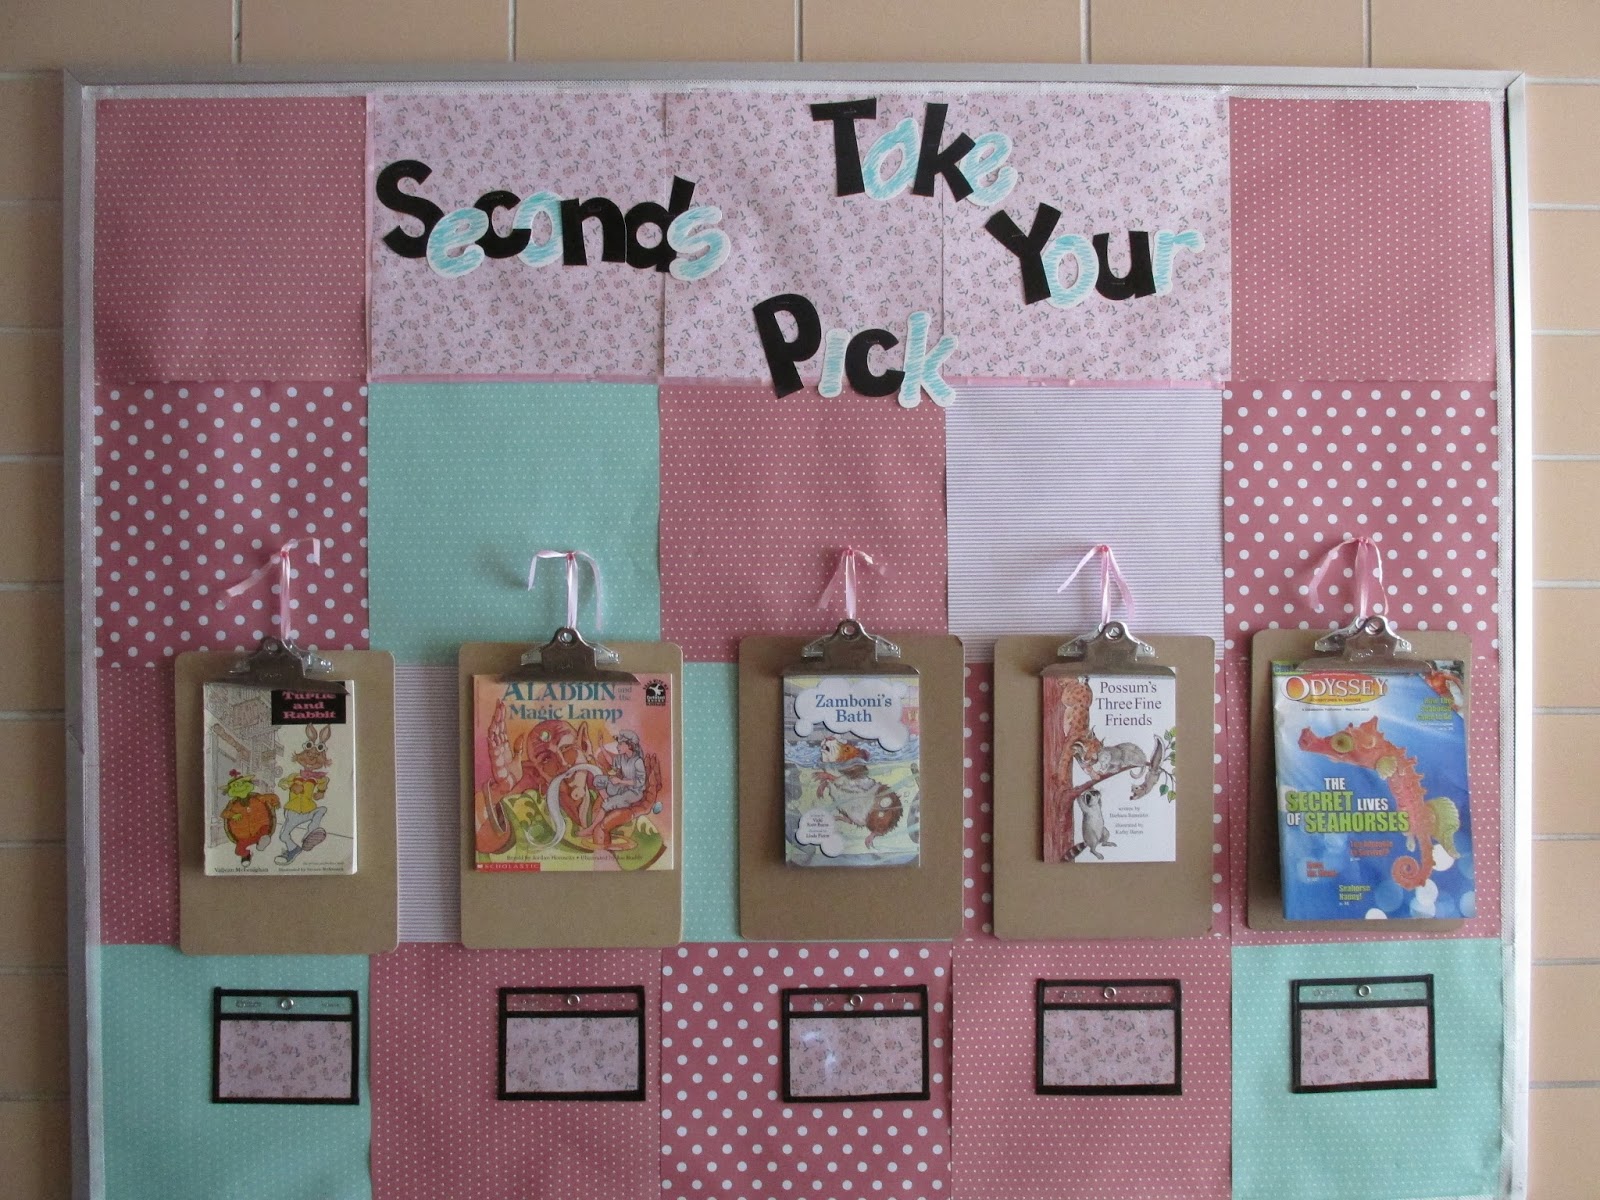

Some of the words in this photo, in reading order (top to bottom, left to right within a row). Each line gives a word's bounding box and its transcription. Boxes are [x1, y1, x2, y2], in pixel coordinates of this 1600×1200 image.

[811, 98, 1018, 206] Take
[376, 160, 730, 280] Seconds
[985, 203, 1205, 309] Your
[754, 293, 958, 407] Pick
[503, 682, 616, 701] ALADDIN
[1100, 681, 1157, 693] Possum's
[1281, 676, 1388, 700] ODYSSEY
[293, 701, 325, 709] and
[816, 694, 892, 707] Zamboni's
[1095, 697, 1133, 710] Three
[1134, 697, 1162, 710] Fine
[282, 711, 336, 719] Rabbit
[509, 704, 563, 720] Magic
[567, 704, 623, 724] Lamp
[835, 709, 872, 722] Bath
[1105, 713, 1152, 726] Friends
[1324, 777, 1345, 790] THE
[1286, 791, 1353, 812] SECRET
[1357, 798, 1389, 811] LIVES
[1287, 812, 1301, 826] OF
[1304, 812, 1409, 833] SEAHORSES
